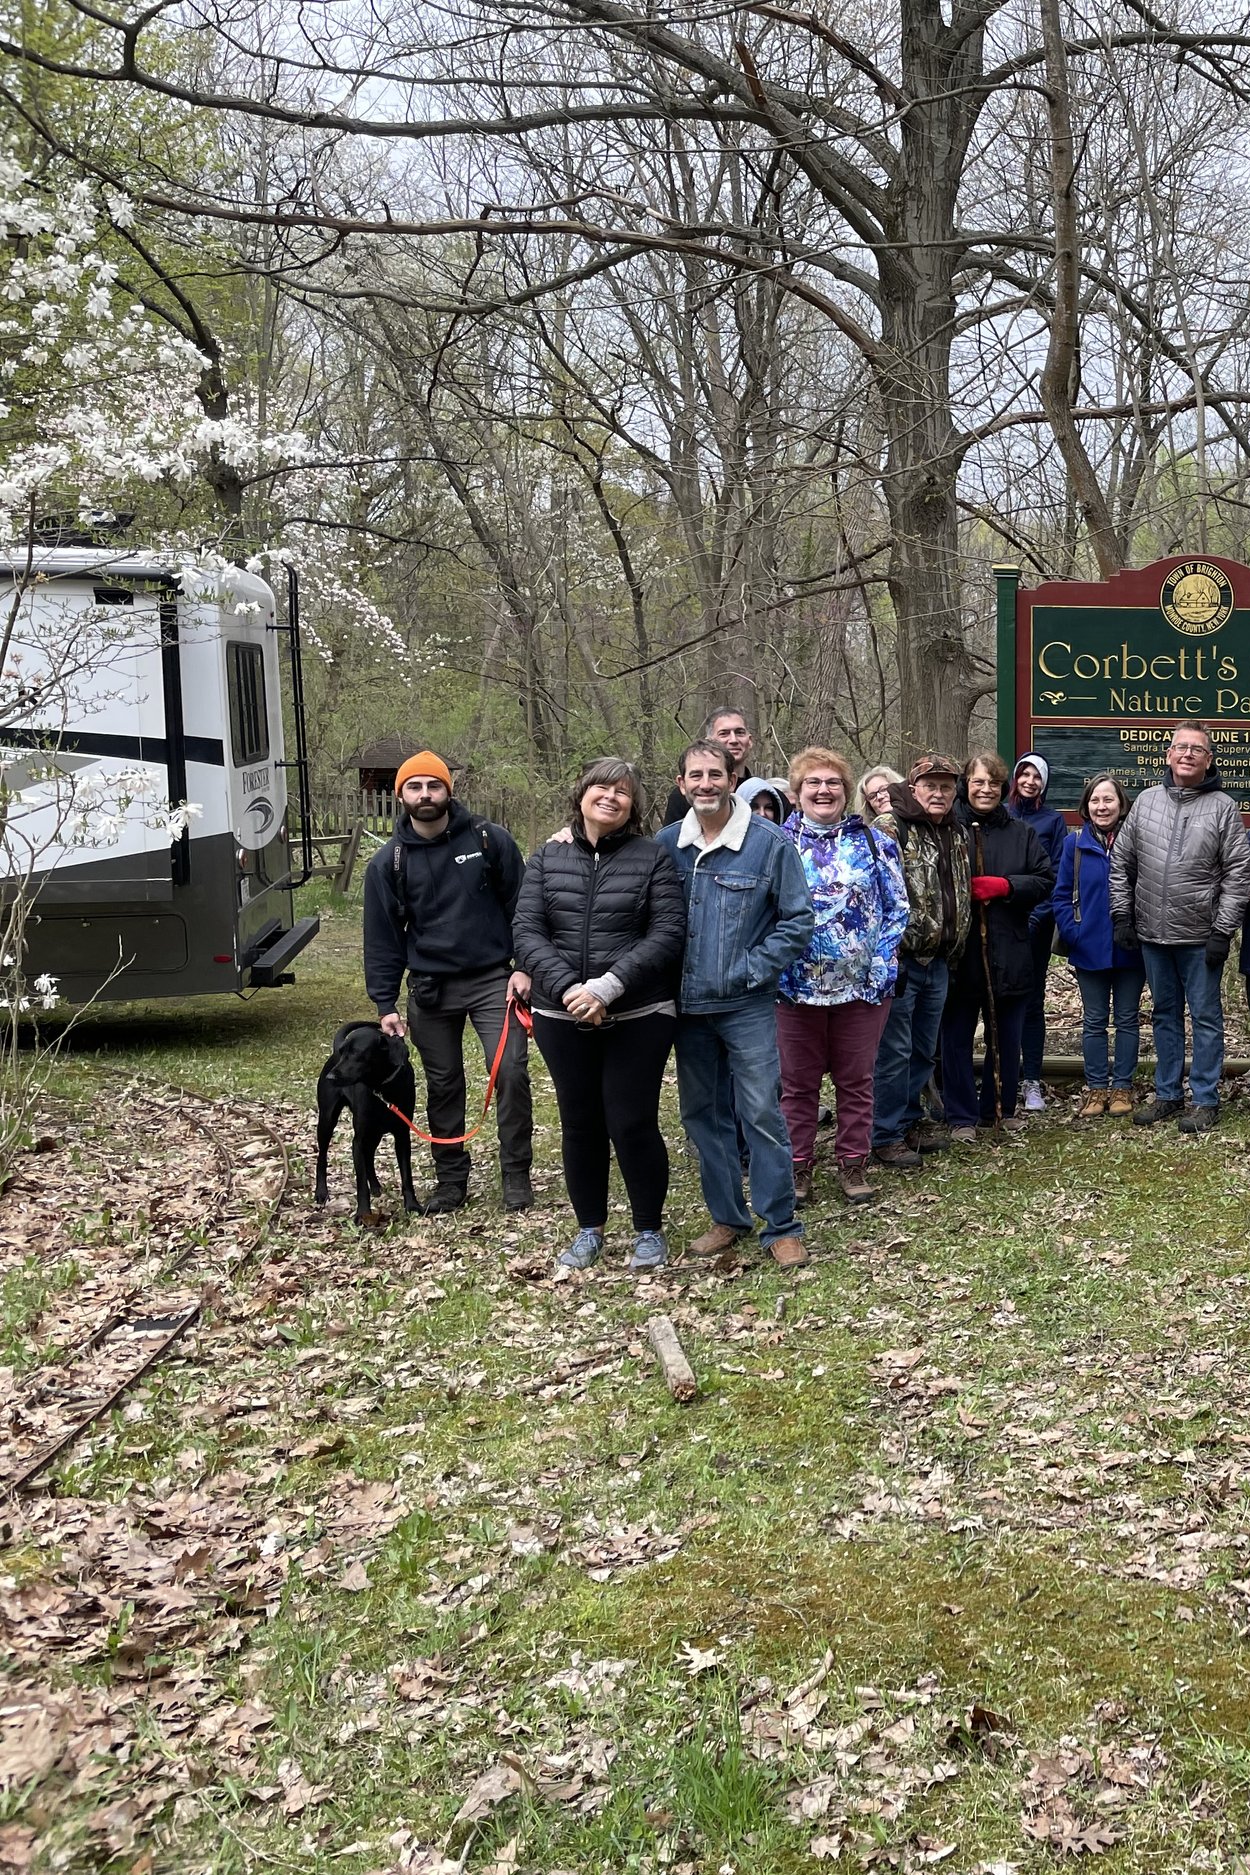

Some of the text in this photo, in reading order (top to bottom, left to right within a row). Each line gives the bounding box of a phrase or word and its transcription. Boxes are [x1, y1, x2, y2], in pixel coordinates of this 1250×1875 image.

[1167, 564, 1228, 588] TOWN OF BRIGHTON
[1216, 605, 1230, 621] YORK
[1038, 641, 1238, 681] Corbett's
[1109, 688, 1202, 712] Nature
[1211, 731, 1239, 743] UNE
[1123, 742, 1158, 752] Sandra
[1162, 743, 1168, 752] L
[1137, 756, 1168, 768] Brigh
[1106, 767, 1136, 776] James
[1152, 768, 1164, 776] Vo
[1132, 778, 1140, 787] J.
